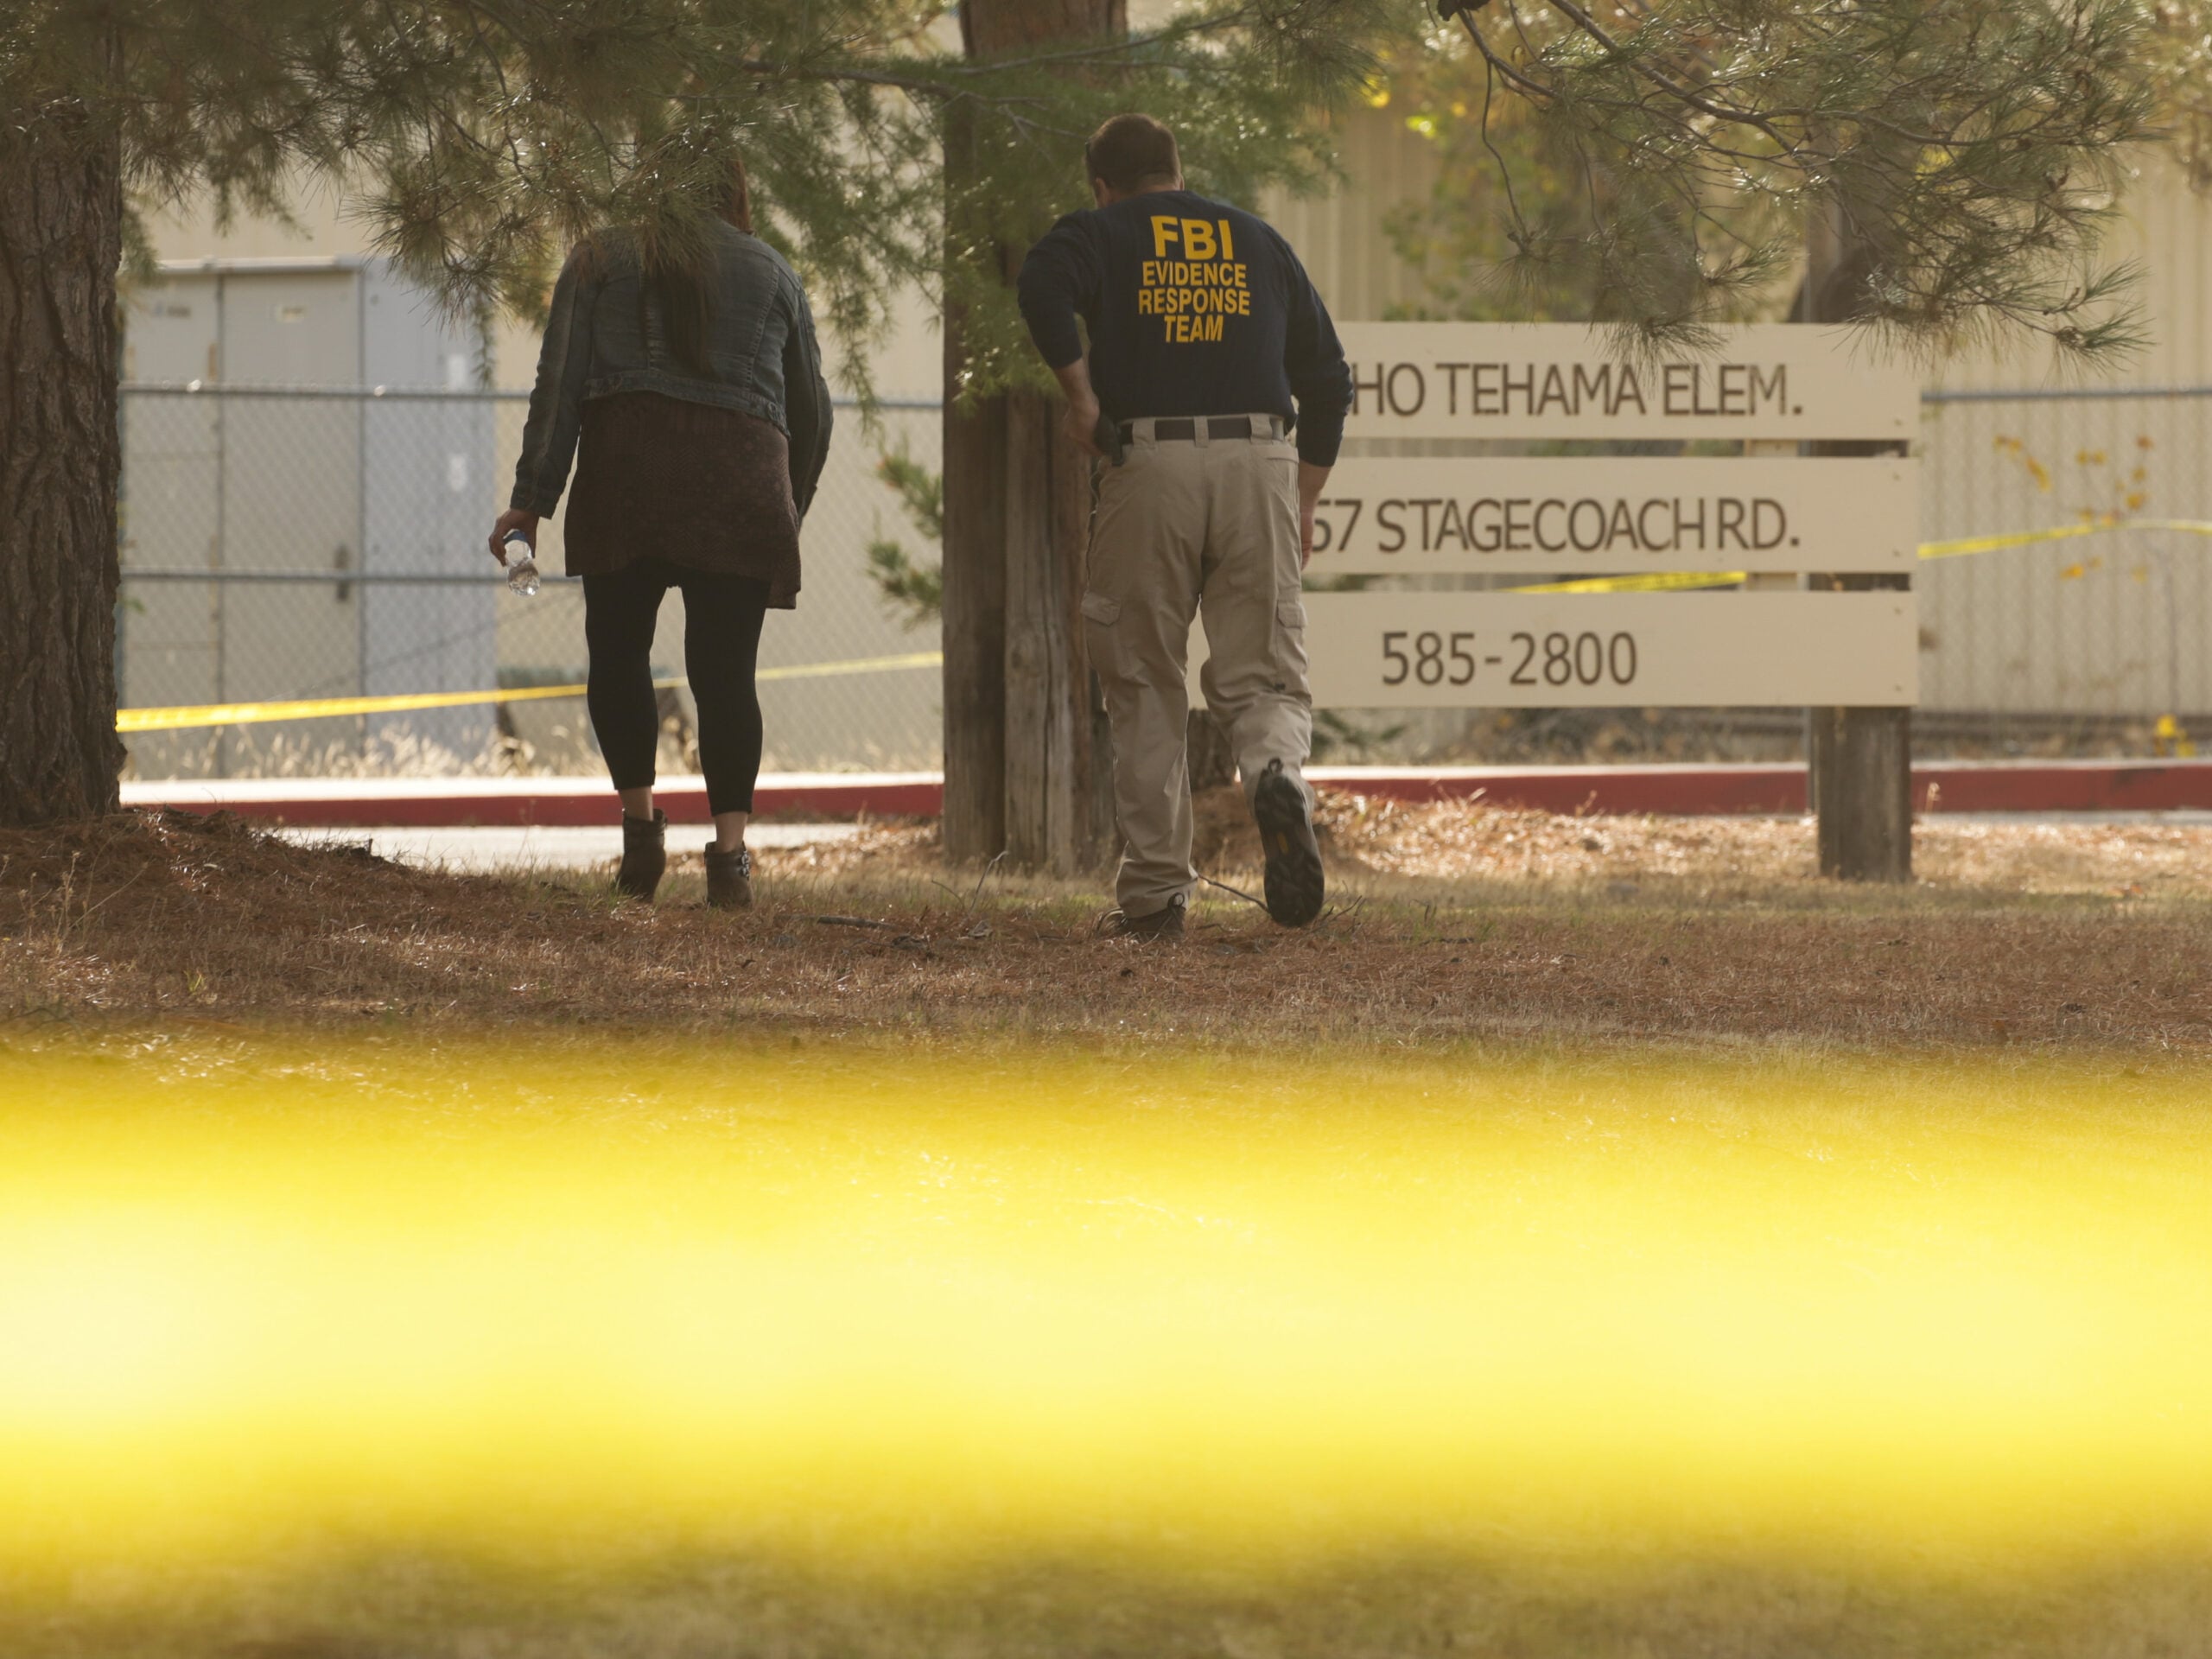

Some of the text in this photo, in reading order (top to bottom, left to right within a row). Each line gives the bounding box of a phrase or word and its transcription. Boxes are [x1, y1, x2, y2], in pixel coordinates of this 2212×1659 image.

[1150, 215, 1234, 260] FBI
[1142, 261, 1247, 288] EVIDENCE
[1138, 288, 1250, 316] RESPONSE
[1164, 315, 1224, 342] TEAM
[1435, 362, 1647, 416] TEHAMA
[1663, 364, 1803, 416] ELEM.
[1376, 499, 1705, 552] STAGECOACH
[1718, 498, 1800, 550] RD.
[1382, 631, 1637, 686] 585-2800
